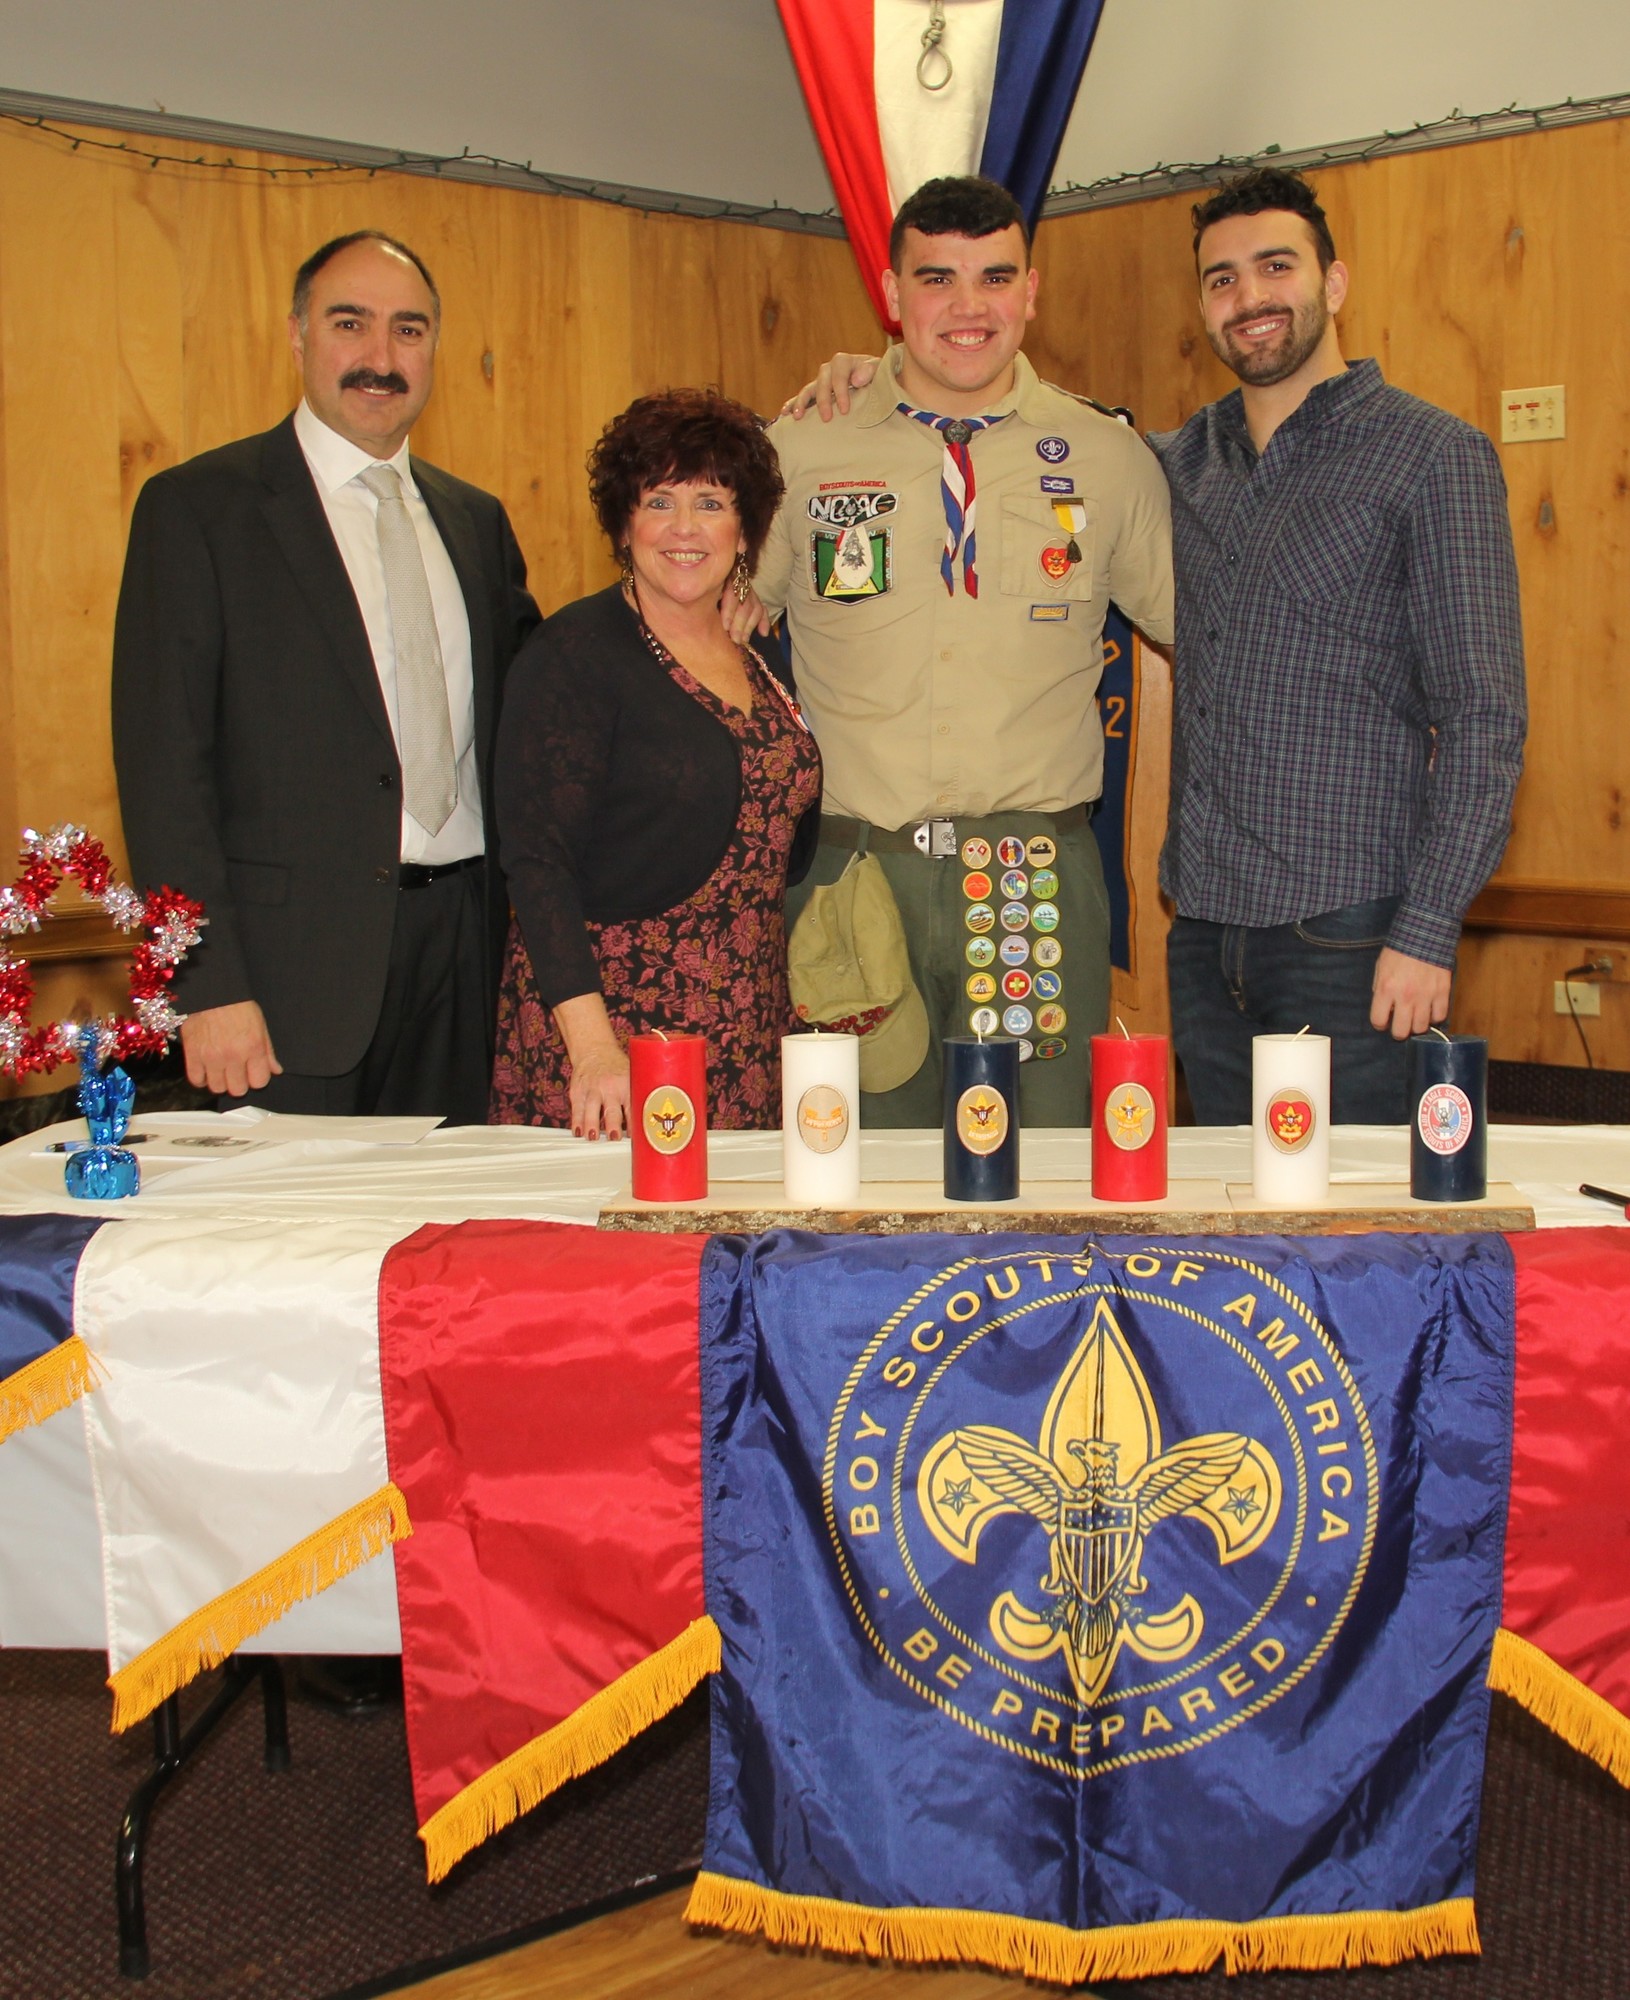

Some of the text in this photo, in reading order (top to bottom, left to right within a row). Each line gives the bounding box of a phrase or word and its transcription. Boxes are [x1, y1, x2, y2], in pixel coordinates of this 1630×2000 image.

[1423, 1128, 1443, 1149] SCOUTS
[1445, 1141, 1454, 1149] OF
[1455, 1113, 1469, 1143] AMERICA
[1424, 1088, 1464, 1105] EAGLE SCOUT
[850, 1253, 1354, 1545] BOY SCOUTS OF AMERICA
[902, 1626, 1287, 1755] BE PREPARED
